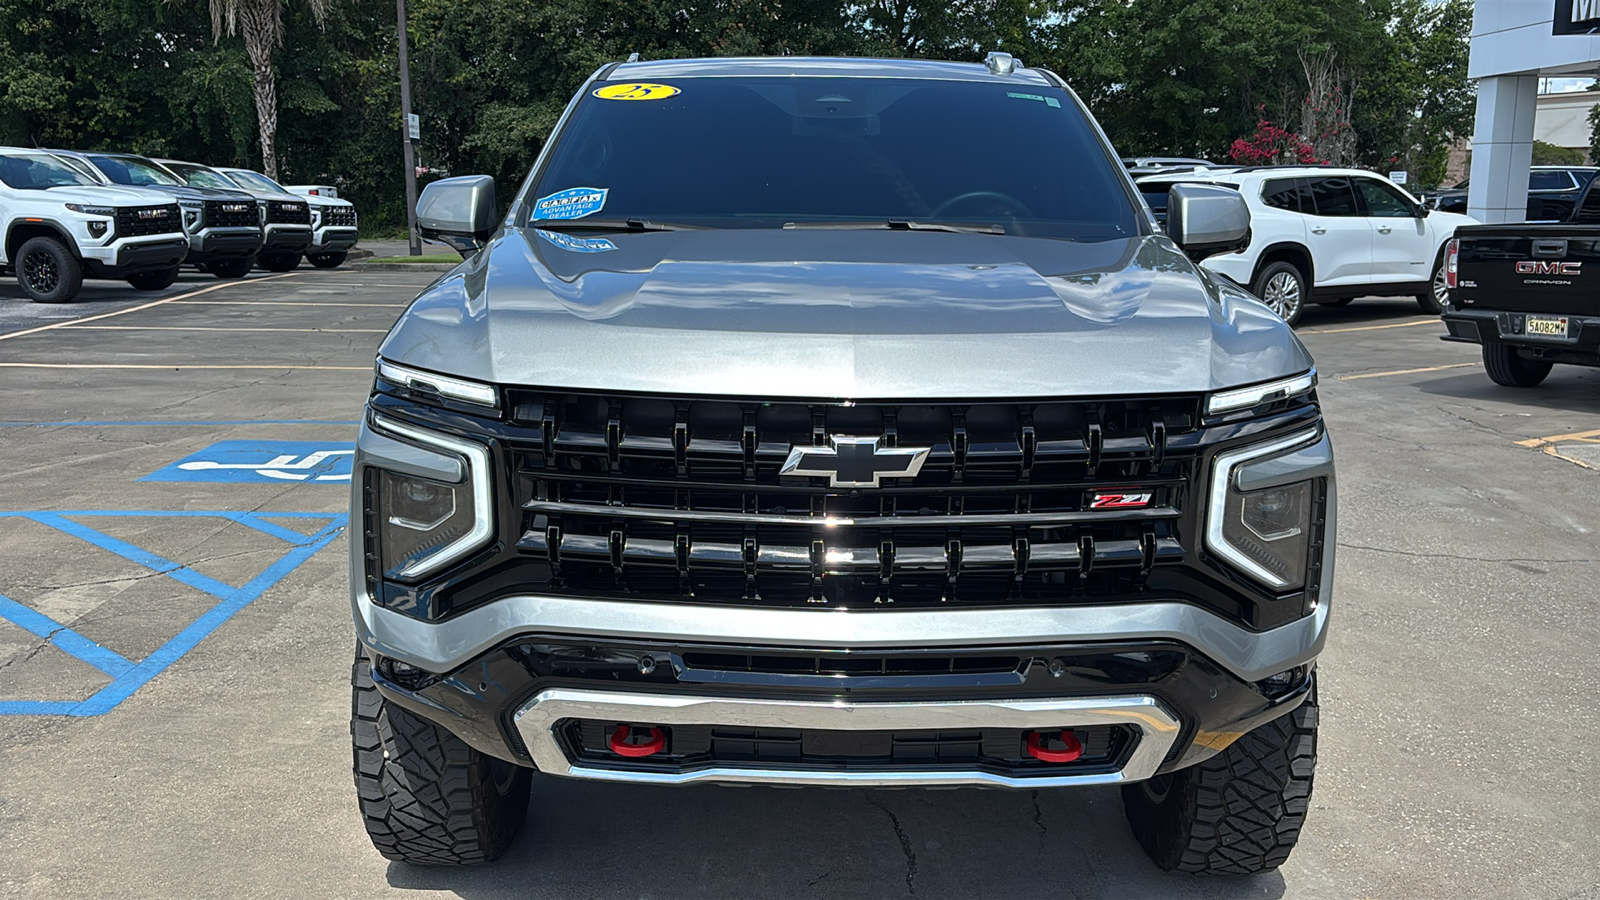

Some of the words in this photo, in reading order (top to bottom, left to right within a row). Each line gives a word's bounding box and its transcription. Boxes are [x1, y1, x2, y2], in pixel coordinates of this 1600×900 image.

[611, 85, 662, 98] 25
[540, 194, 601, 209] CARFAX
[542, 203, 594, 215] ADVANTAGE
[549, 210, 583, 219] DEALER
[1516, 261, 1582, 275] GMC
[1529, 321, 1566, 335] 5A082MW
[1090, 493, 1152, 508] Z71
